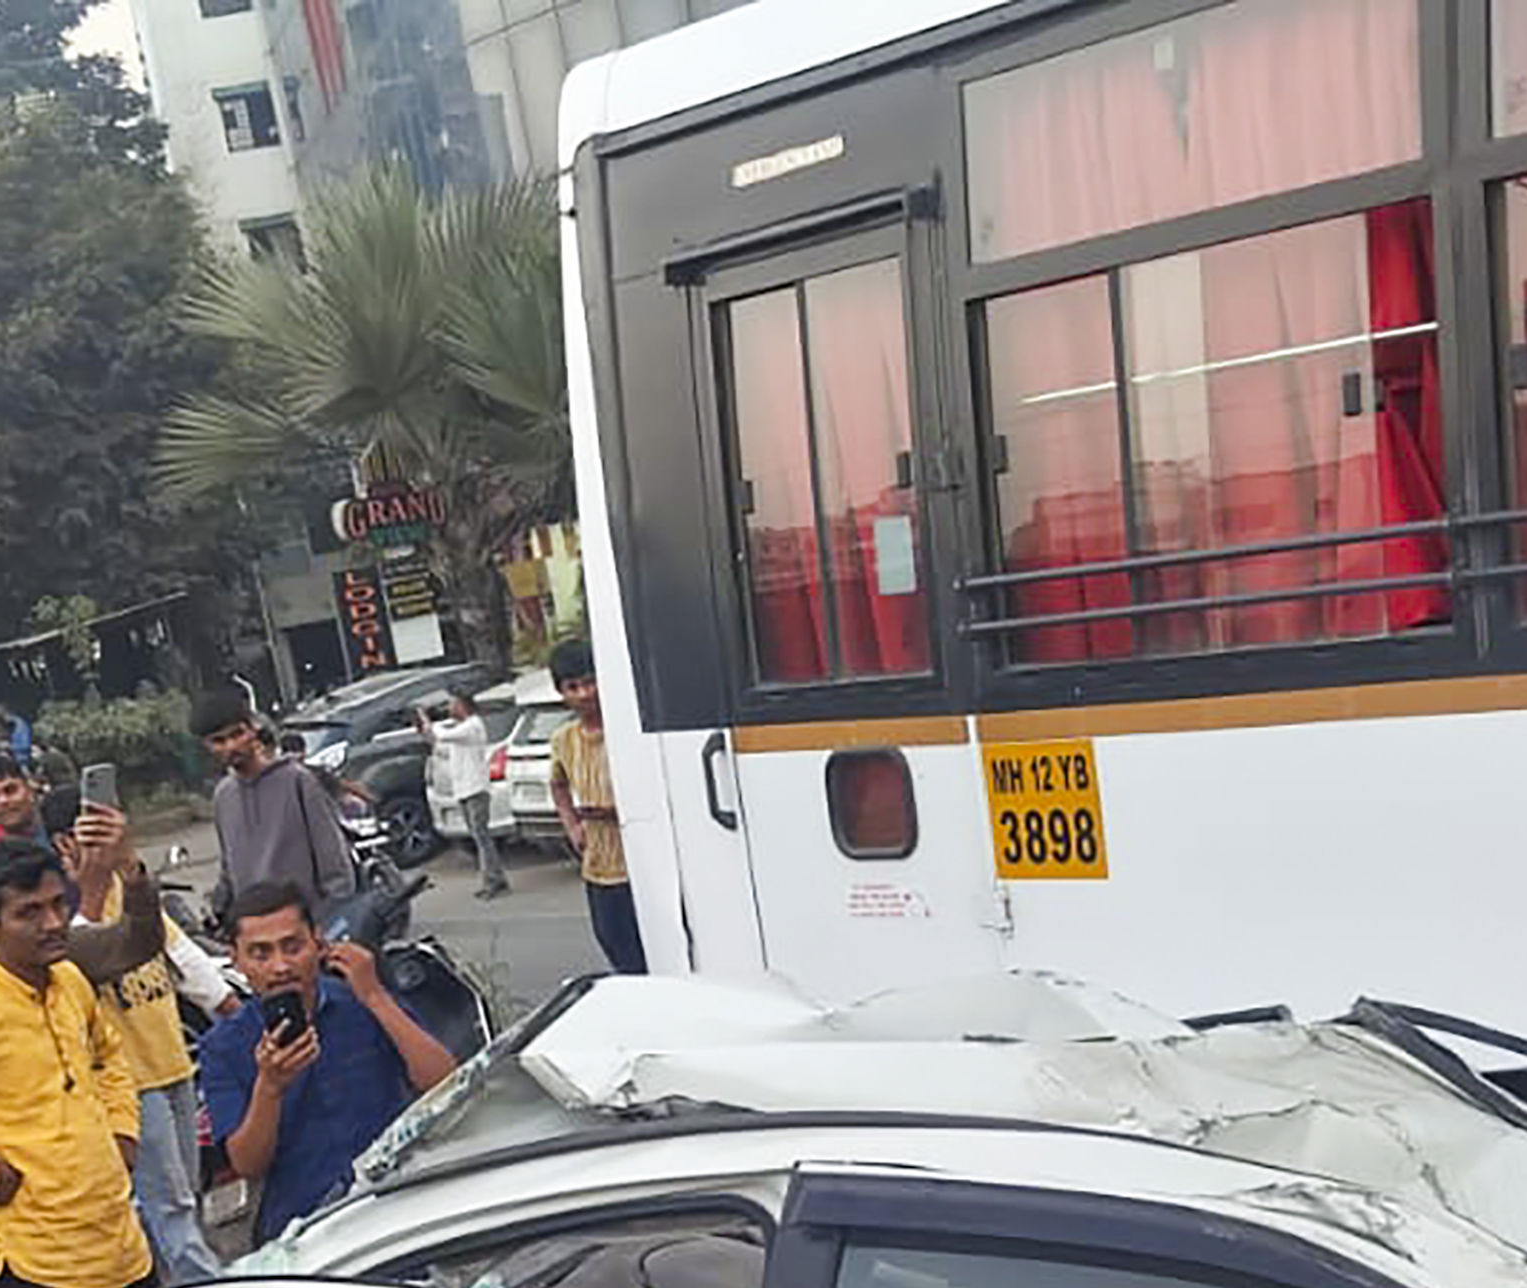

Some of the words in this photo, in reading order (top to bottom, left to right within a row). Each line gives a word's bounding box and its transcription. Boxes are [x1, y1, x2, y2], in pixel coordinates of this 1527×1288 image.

[347, 489, 445, 539] GRAND
[992, 758, 1024, 793] MH
[1031, 755, 1054, 792] 12
[1000, 808, 1098, 865] 3898
